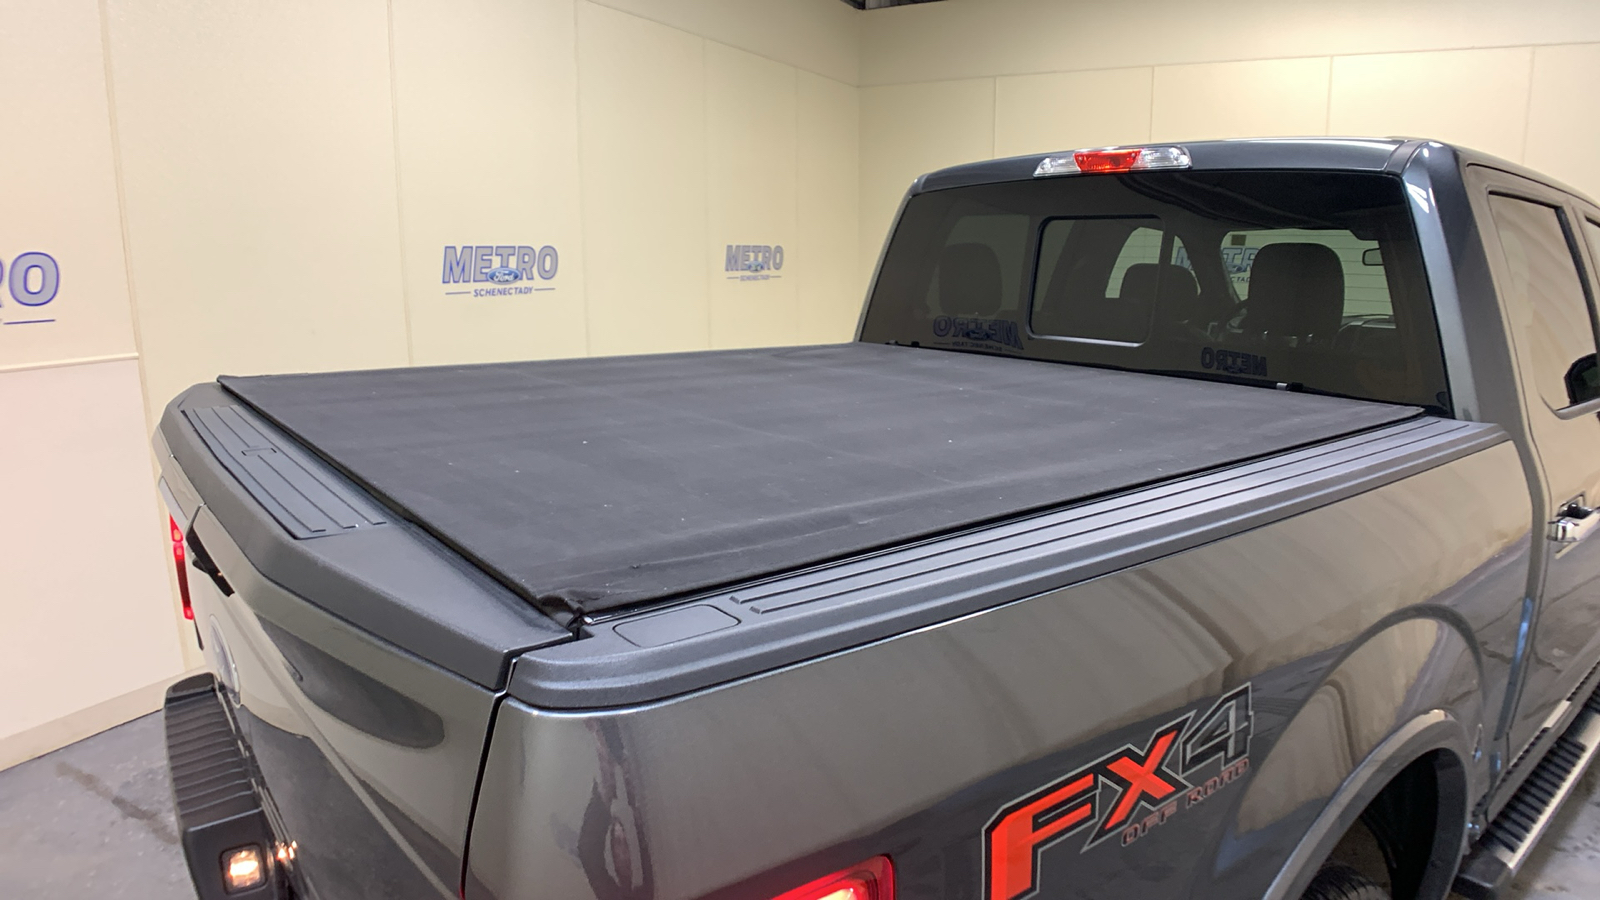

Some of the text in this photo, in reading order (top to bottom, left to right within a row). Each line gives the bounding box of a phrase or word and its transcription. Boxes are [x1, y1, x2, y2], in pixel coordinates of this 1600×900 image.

[442, 245, 559, 284] METRO
[725, 245, 784, 271] METRO
[473, 286, 534, 298] SCHENECTADY
[981, 682, 1254, 900] FX4
[1121, 758, 1250, 847] OFF ROAD
